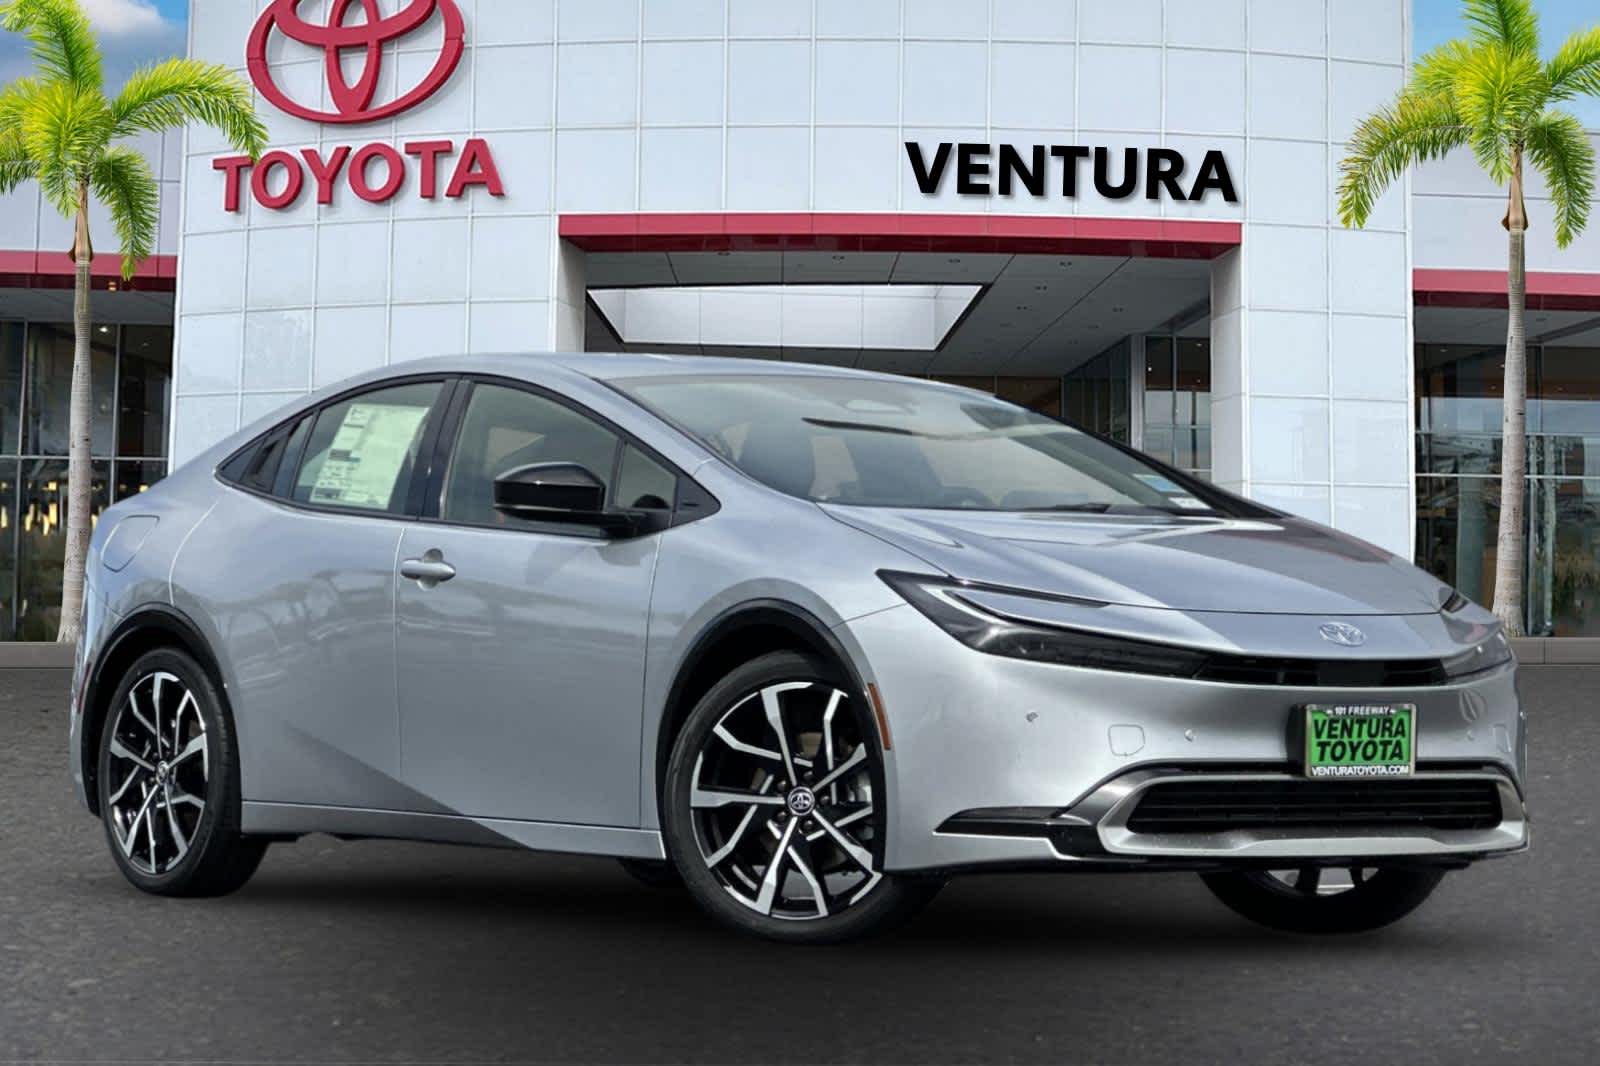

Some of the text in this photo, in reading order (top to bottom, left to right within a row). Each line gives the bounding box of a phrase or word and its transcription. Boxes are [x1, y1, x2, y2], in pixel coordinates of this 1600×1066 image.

[212, 138, 505, 212] TOYOTA
[904, 141, 1238, 202] VENTURA
[1335, 706, 1390, 715] 101 FREEWAY
[1313, 718, 1406, 739] VENTURA
[1316, 740, 1404, 761] TOYOTA
[1311, 765, 1409, 776] VENTURATOYOTA.COM
